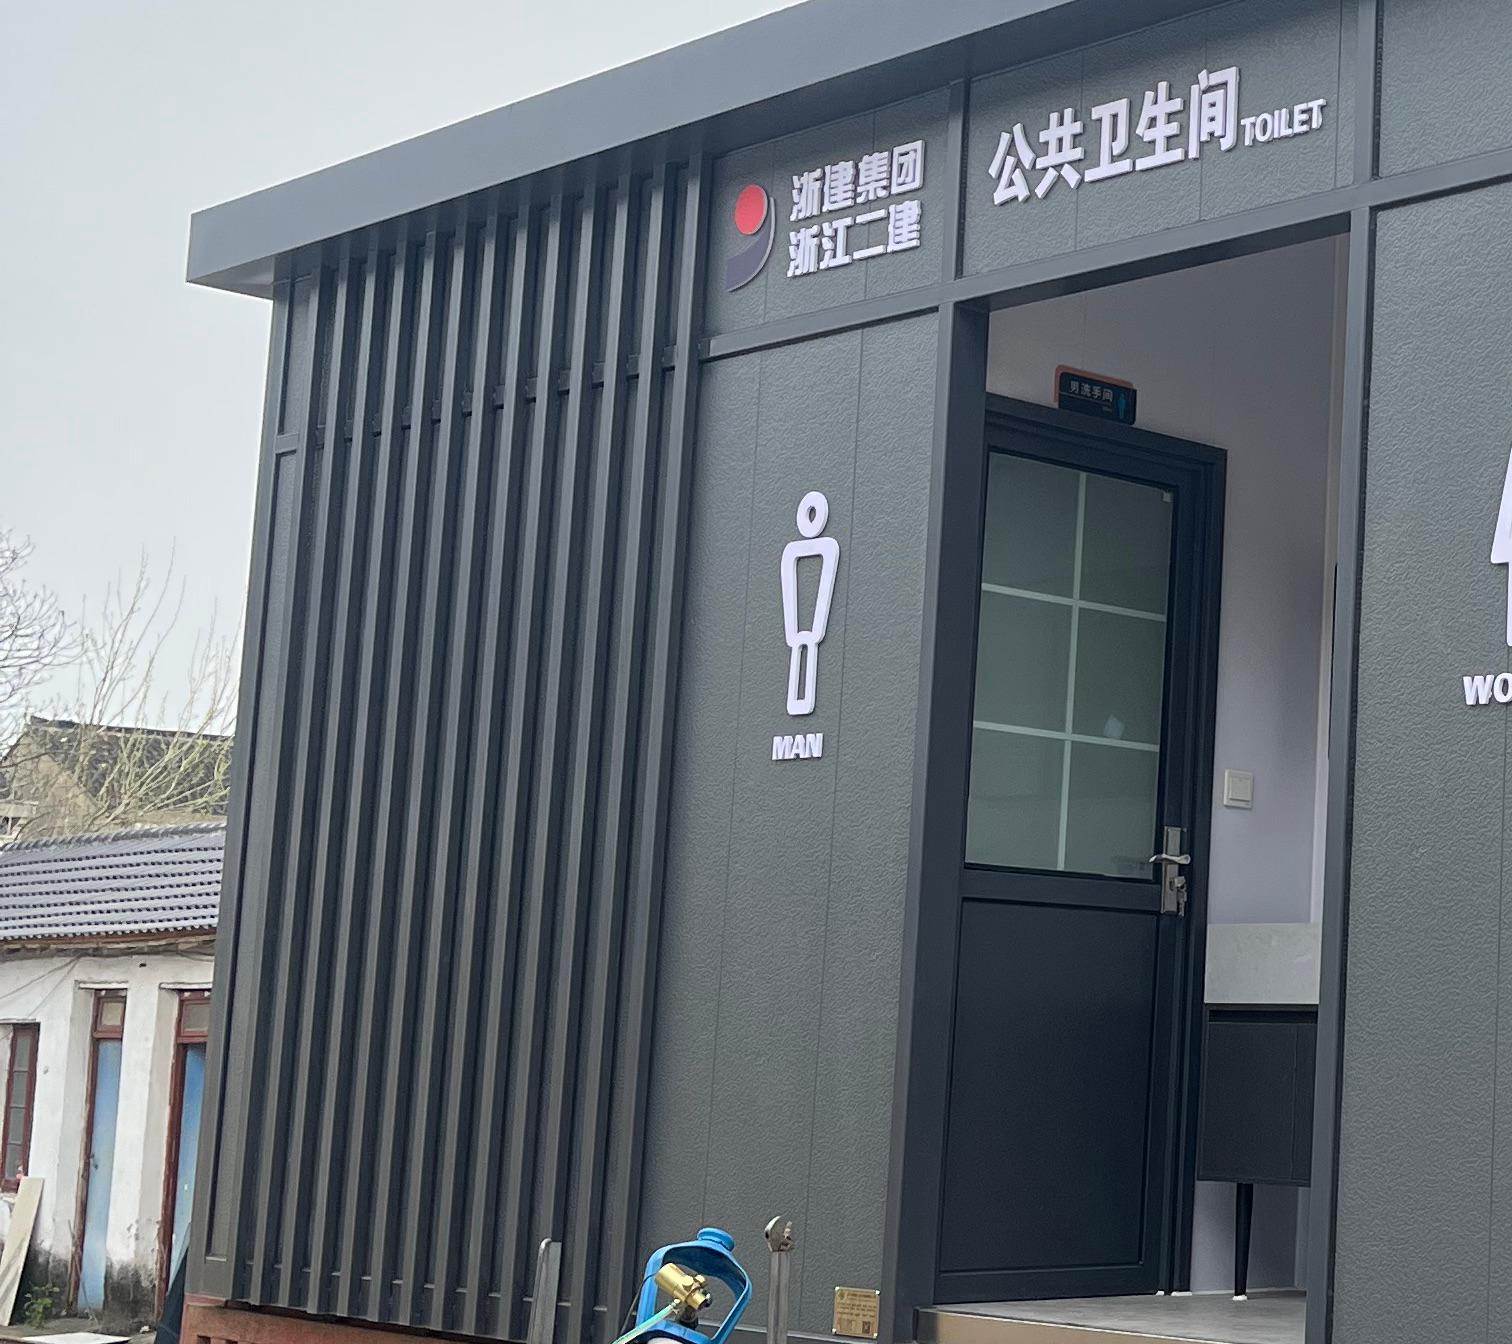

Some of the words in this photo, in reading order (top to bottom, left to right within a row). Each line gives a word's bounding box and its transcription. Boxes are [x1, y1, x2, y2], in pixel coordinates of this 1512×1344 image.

[988, 66, 1240, 205] 公共卫生间
[1240, 99, 1327, 146] TOILET
[790, 140, 925, 222] 浙建集团
[787, 200, 922, 278] 浙江二建
[1069, 380, 1114, 403] 男洗手间
[771, 732, 824, 761] MAN
